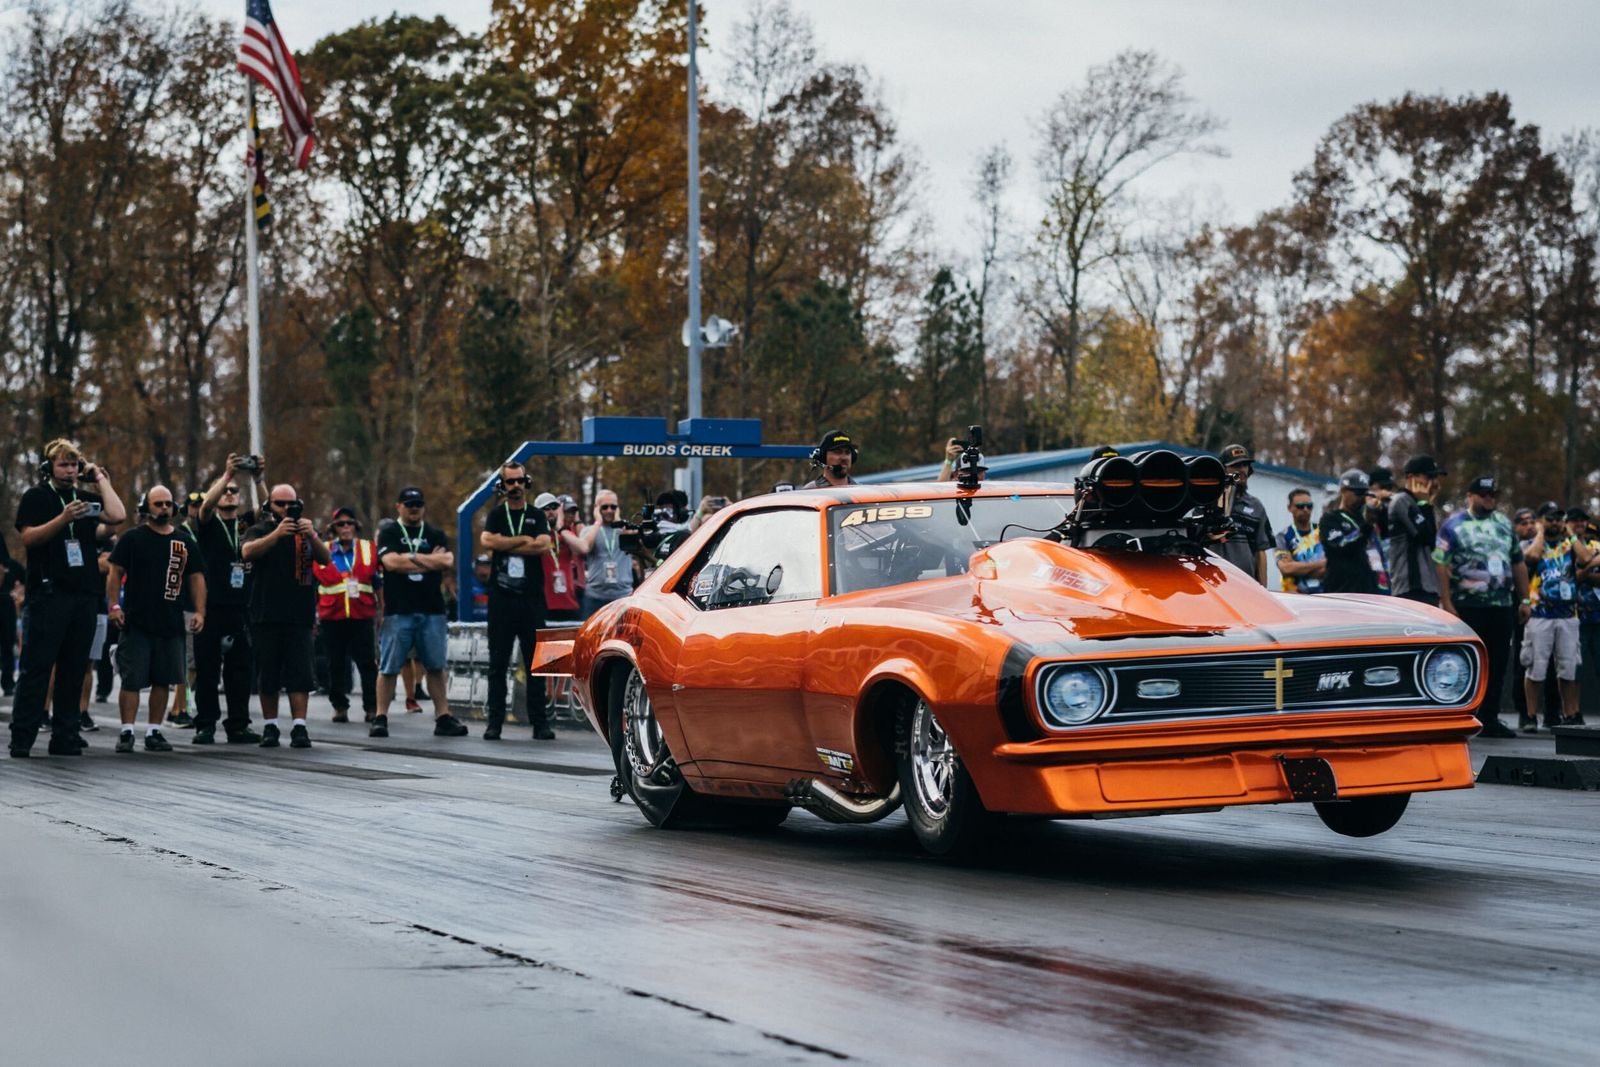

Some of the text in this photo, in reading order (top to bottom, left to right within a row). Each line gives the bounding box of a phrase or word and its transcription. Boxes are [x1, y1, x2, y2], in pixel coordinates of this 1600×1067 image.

[623, 444, 732, 457] BUDDS CREEK
[840, 505, 933, 527] 4199
